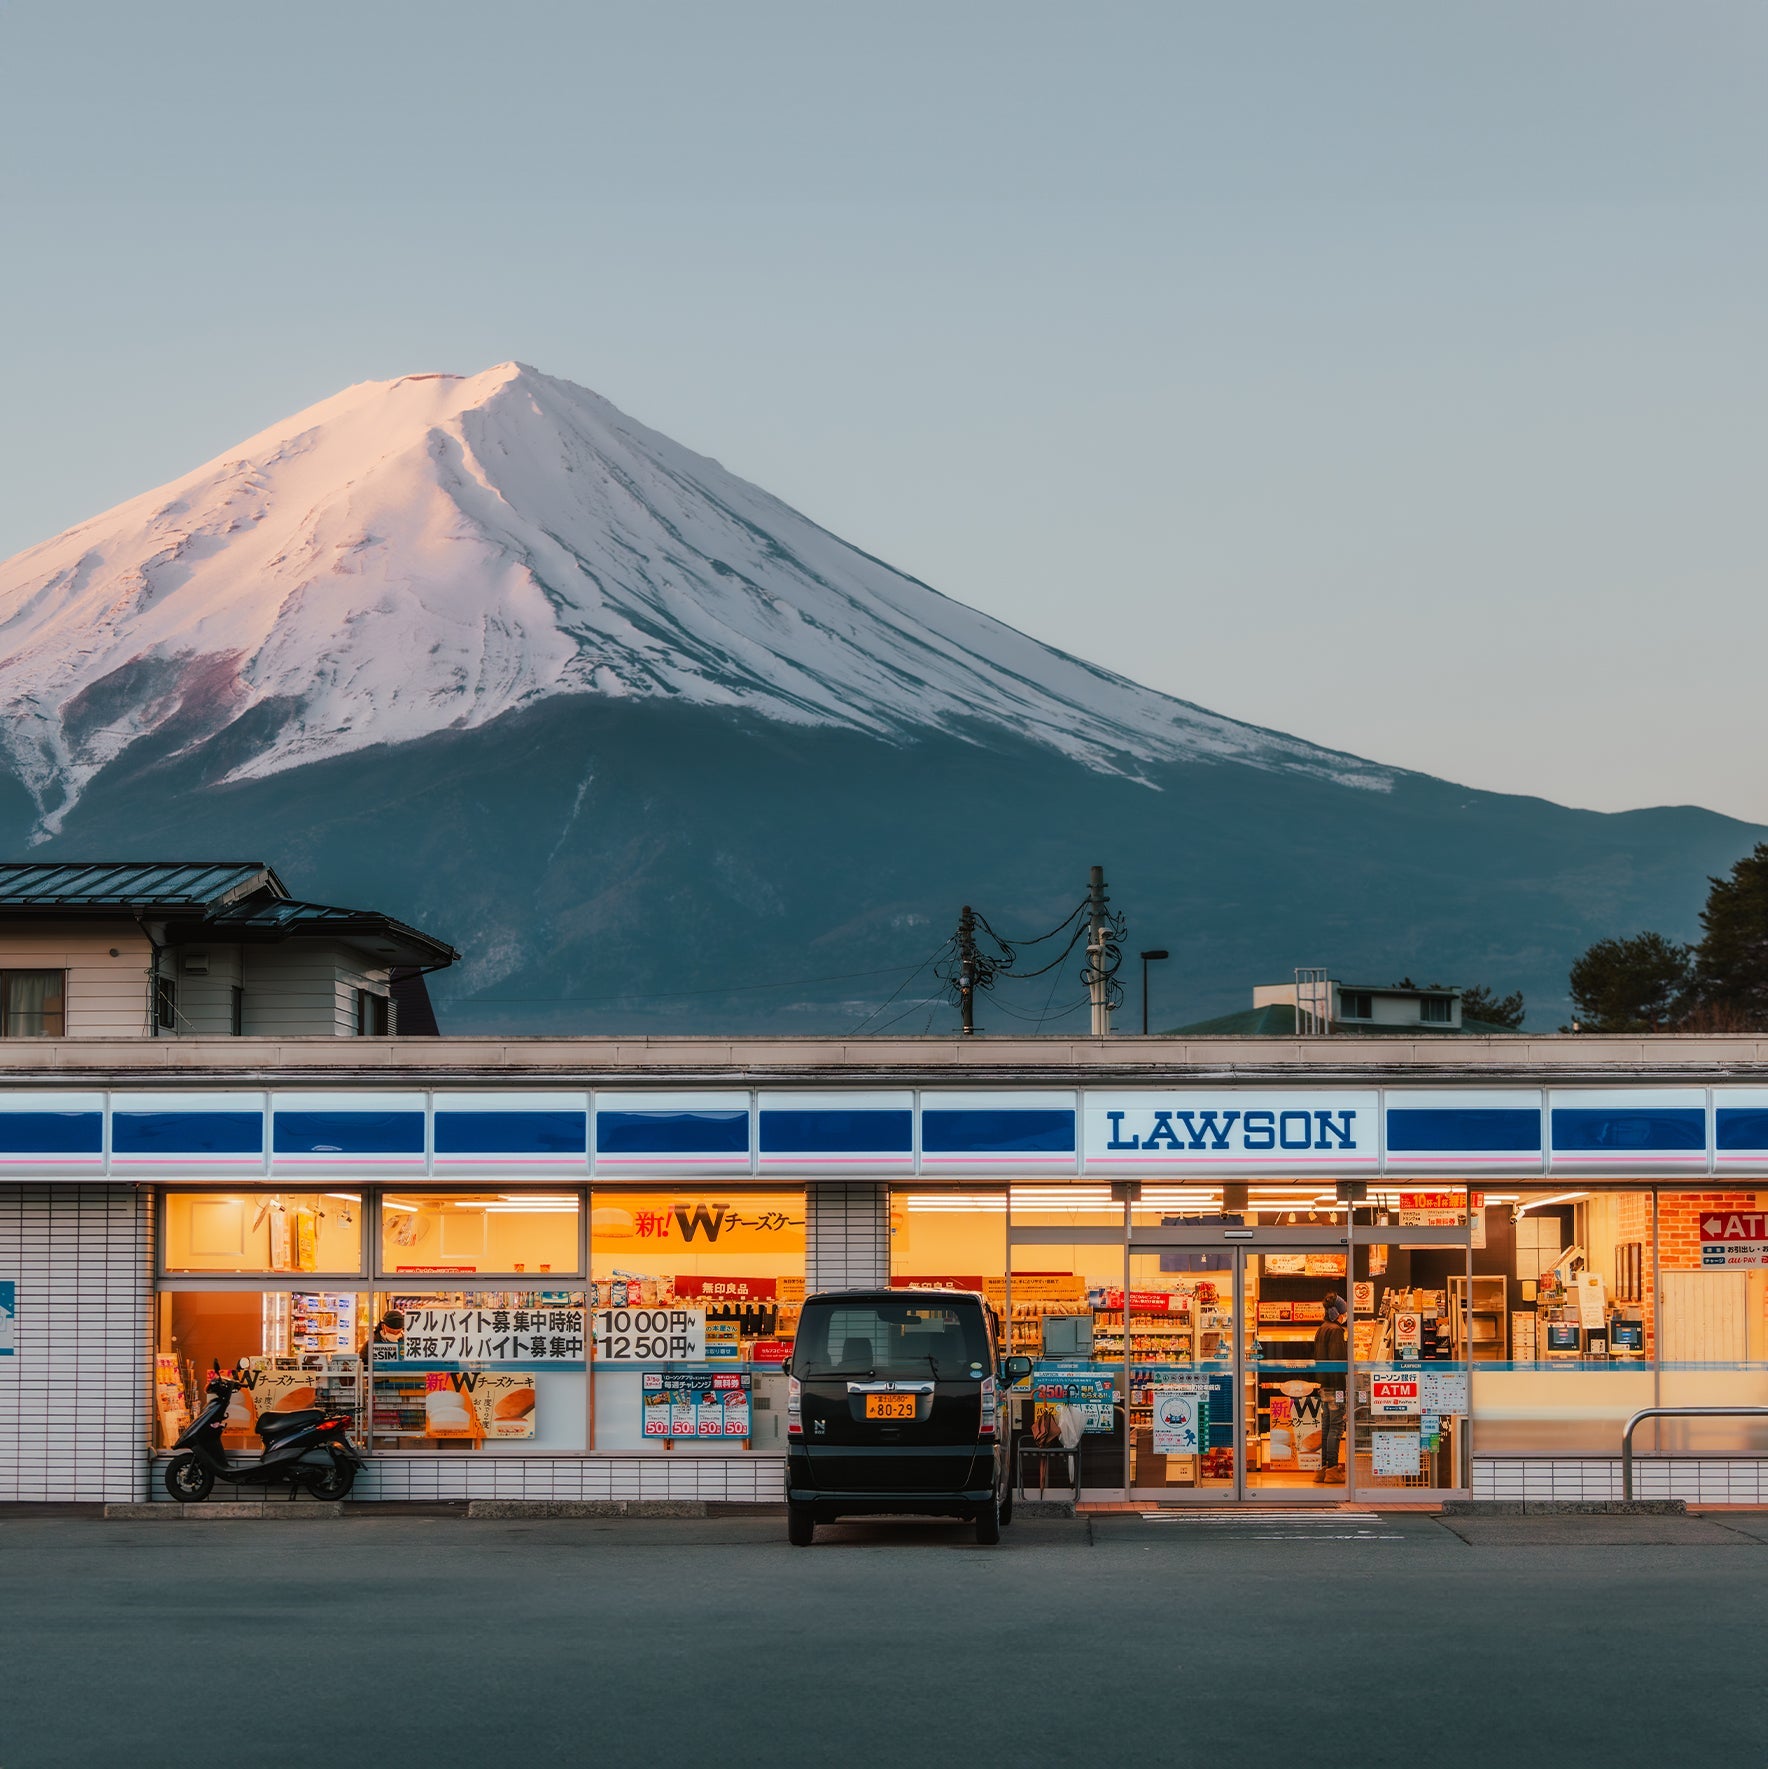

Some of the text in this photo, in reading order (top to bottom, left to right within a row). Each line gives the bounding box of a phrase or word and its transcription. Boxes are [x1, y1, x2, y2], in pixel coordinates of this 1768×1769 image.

[1107, 1110, 1357, 1150] LAWSON
[1723, 1214, 1768, 1238] AT
[702, 1282, 749, 1295] 無印良品
[405, 1310, 583, 1333] アルバイト募集中時給
[405, 1335, 583, 1359] 深夜アルバイト募集中
[373, 1351, 398, 1360] eSIM
[426, 1371, 535, 1394] 新!Wチーズケーキ
[1373, 1373, 1417, 1382] ローソン銀行
[1380, 1384, 1411, 1396] ATM
[877, 1403, 913, 1417] 80-29
[1271, 1418, 1321, 1428] チーズケーキ
